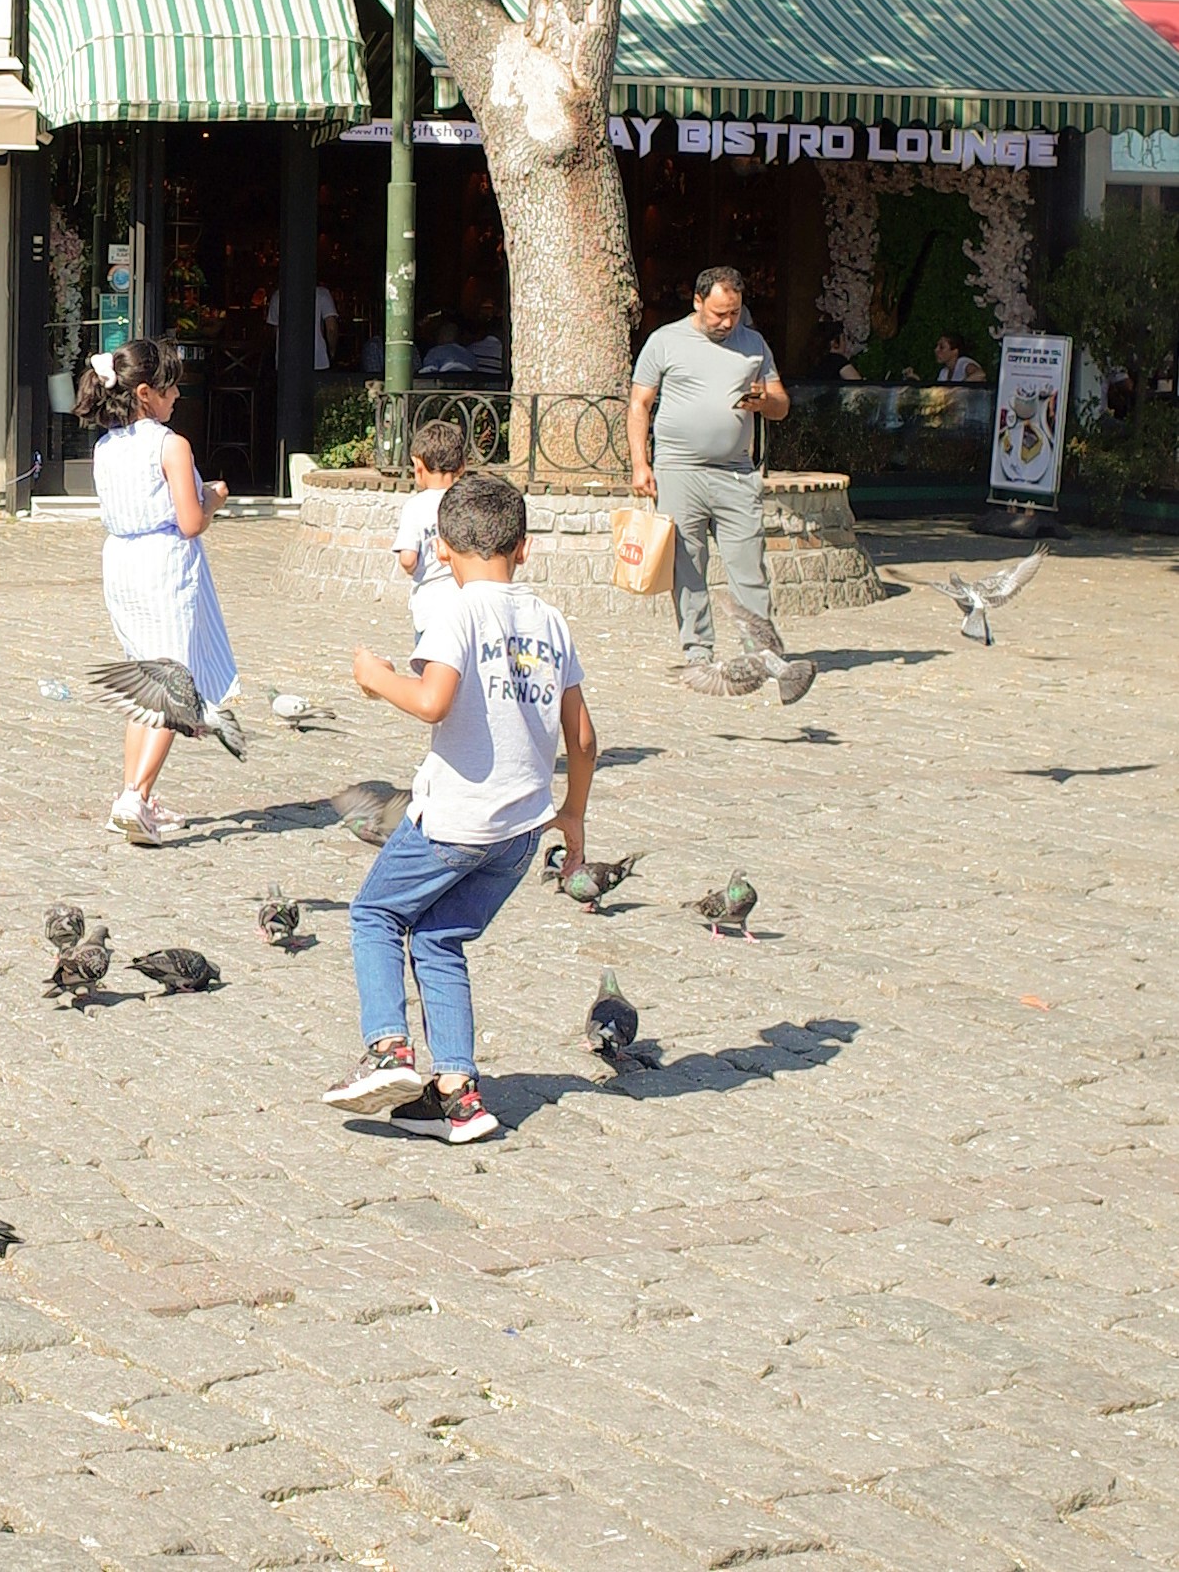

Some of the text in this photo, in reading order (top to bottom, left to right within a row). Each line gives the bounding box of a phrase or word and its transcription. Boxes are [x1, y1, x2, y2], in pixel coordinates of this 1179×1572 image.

[676, 118, 855, 165] BISTRO
[866, 125, 1060, 173] LOUNGE
[480, 636, 563, 671] MCKEY
